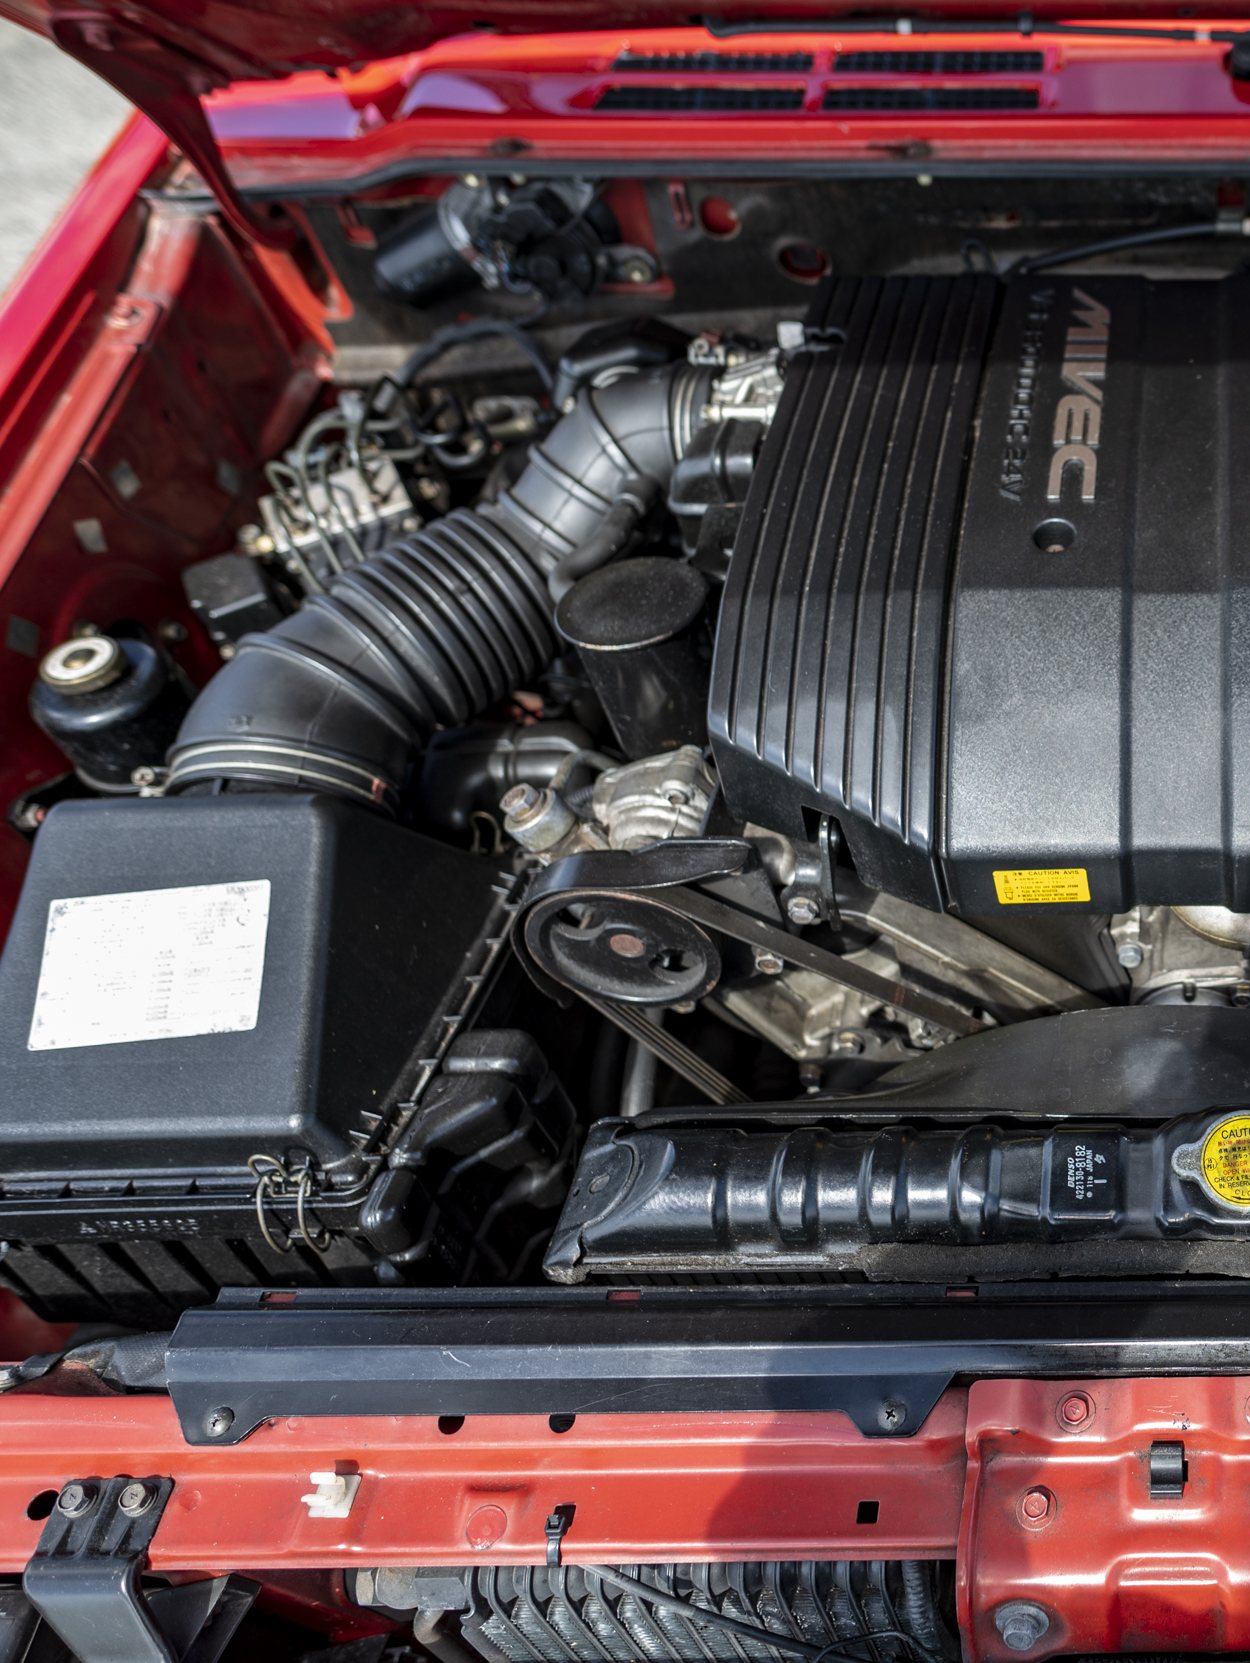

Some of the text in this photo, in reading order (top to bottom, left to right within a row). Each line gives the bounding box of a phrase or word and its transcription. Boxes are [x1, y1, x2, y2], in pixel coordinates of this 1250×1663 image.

[1046, 286, 1112, 503] MIVEC
[1067, 1157, 1075, 1188] DENSO
[1075, 1145, 1086, 1200] 422130-8182
[1086, 1149, 1094, 1173] JAPAN
[1222, 1167, 1240, 1176] OPEN
[1214, 1175, 1235, 1184] CHECK
